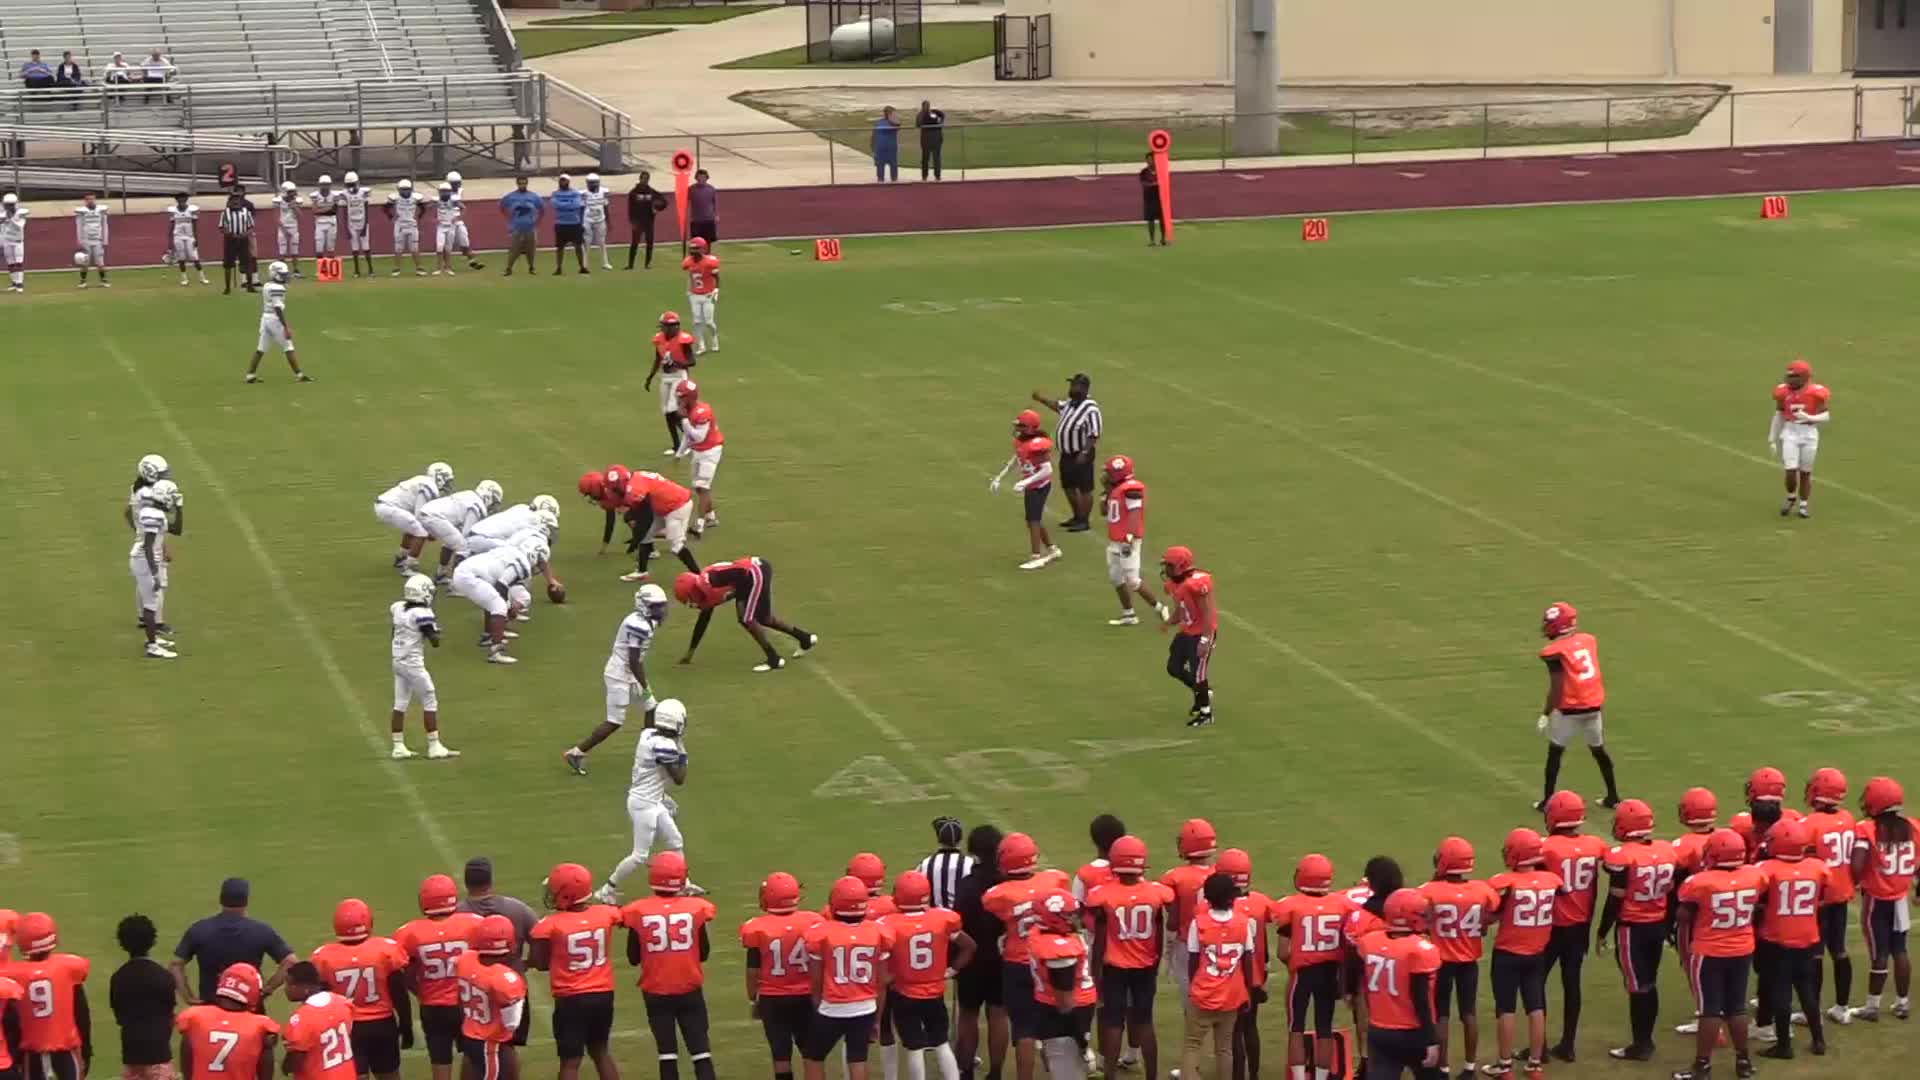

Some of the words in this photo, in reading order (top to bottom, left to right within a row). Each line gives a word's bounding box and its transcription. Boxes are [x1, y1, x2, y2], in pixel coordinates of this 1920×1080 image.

[1767, 197, 1785, 214] 10
[820, 240, 839, 256] 30
[1306, 220, 1325, 238] 20
[319, 260, 340, 277] 40
[1573, 649, 1595, 680] 3
[1561, 856, 1597, 893] 16
[1633, 863, 1675, 901] 32
[1513, 889, 1556, 926] 22
[1711, 889, 1757, 929] 55
[1777, 880, 1817, 916] 12
[641, 912, 694, 952] 33
[1115, 904, 1153, 941] 10
[1301, 914, 1341, 952] 15
[1434, 904, 1482, 938] 24
[567, 927, 606, 971] 51
[769, 937, 810, 976] 14
[832, 946, 876, 984] 16
[909, 932, 934, 970] 6
[335, 966, 379, 1003] 71
[1367, 954, 1399, 997] 71
[28, 980, 53, 1018] 9
[208, 1031, 239, 1071] 7
[320, 1021, 353, 1070] 21
